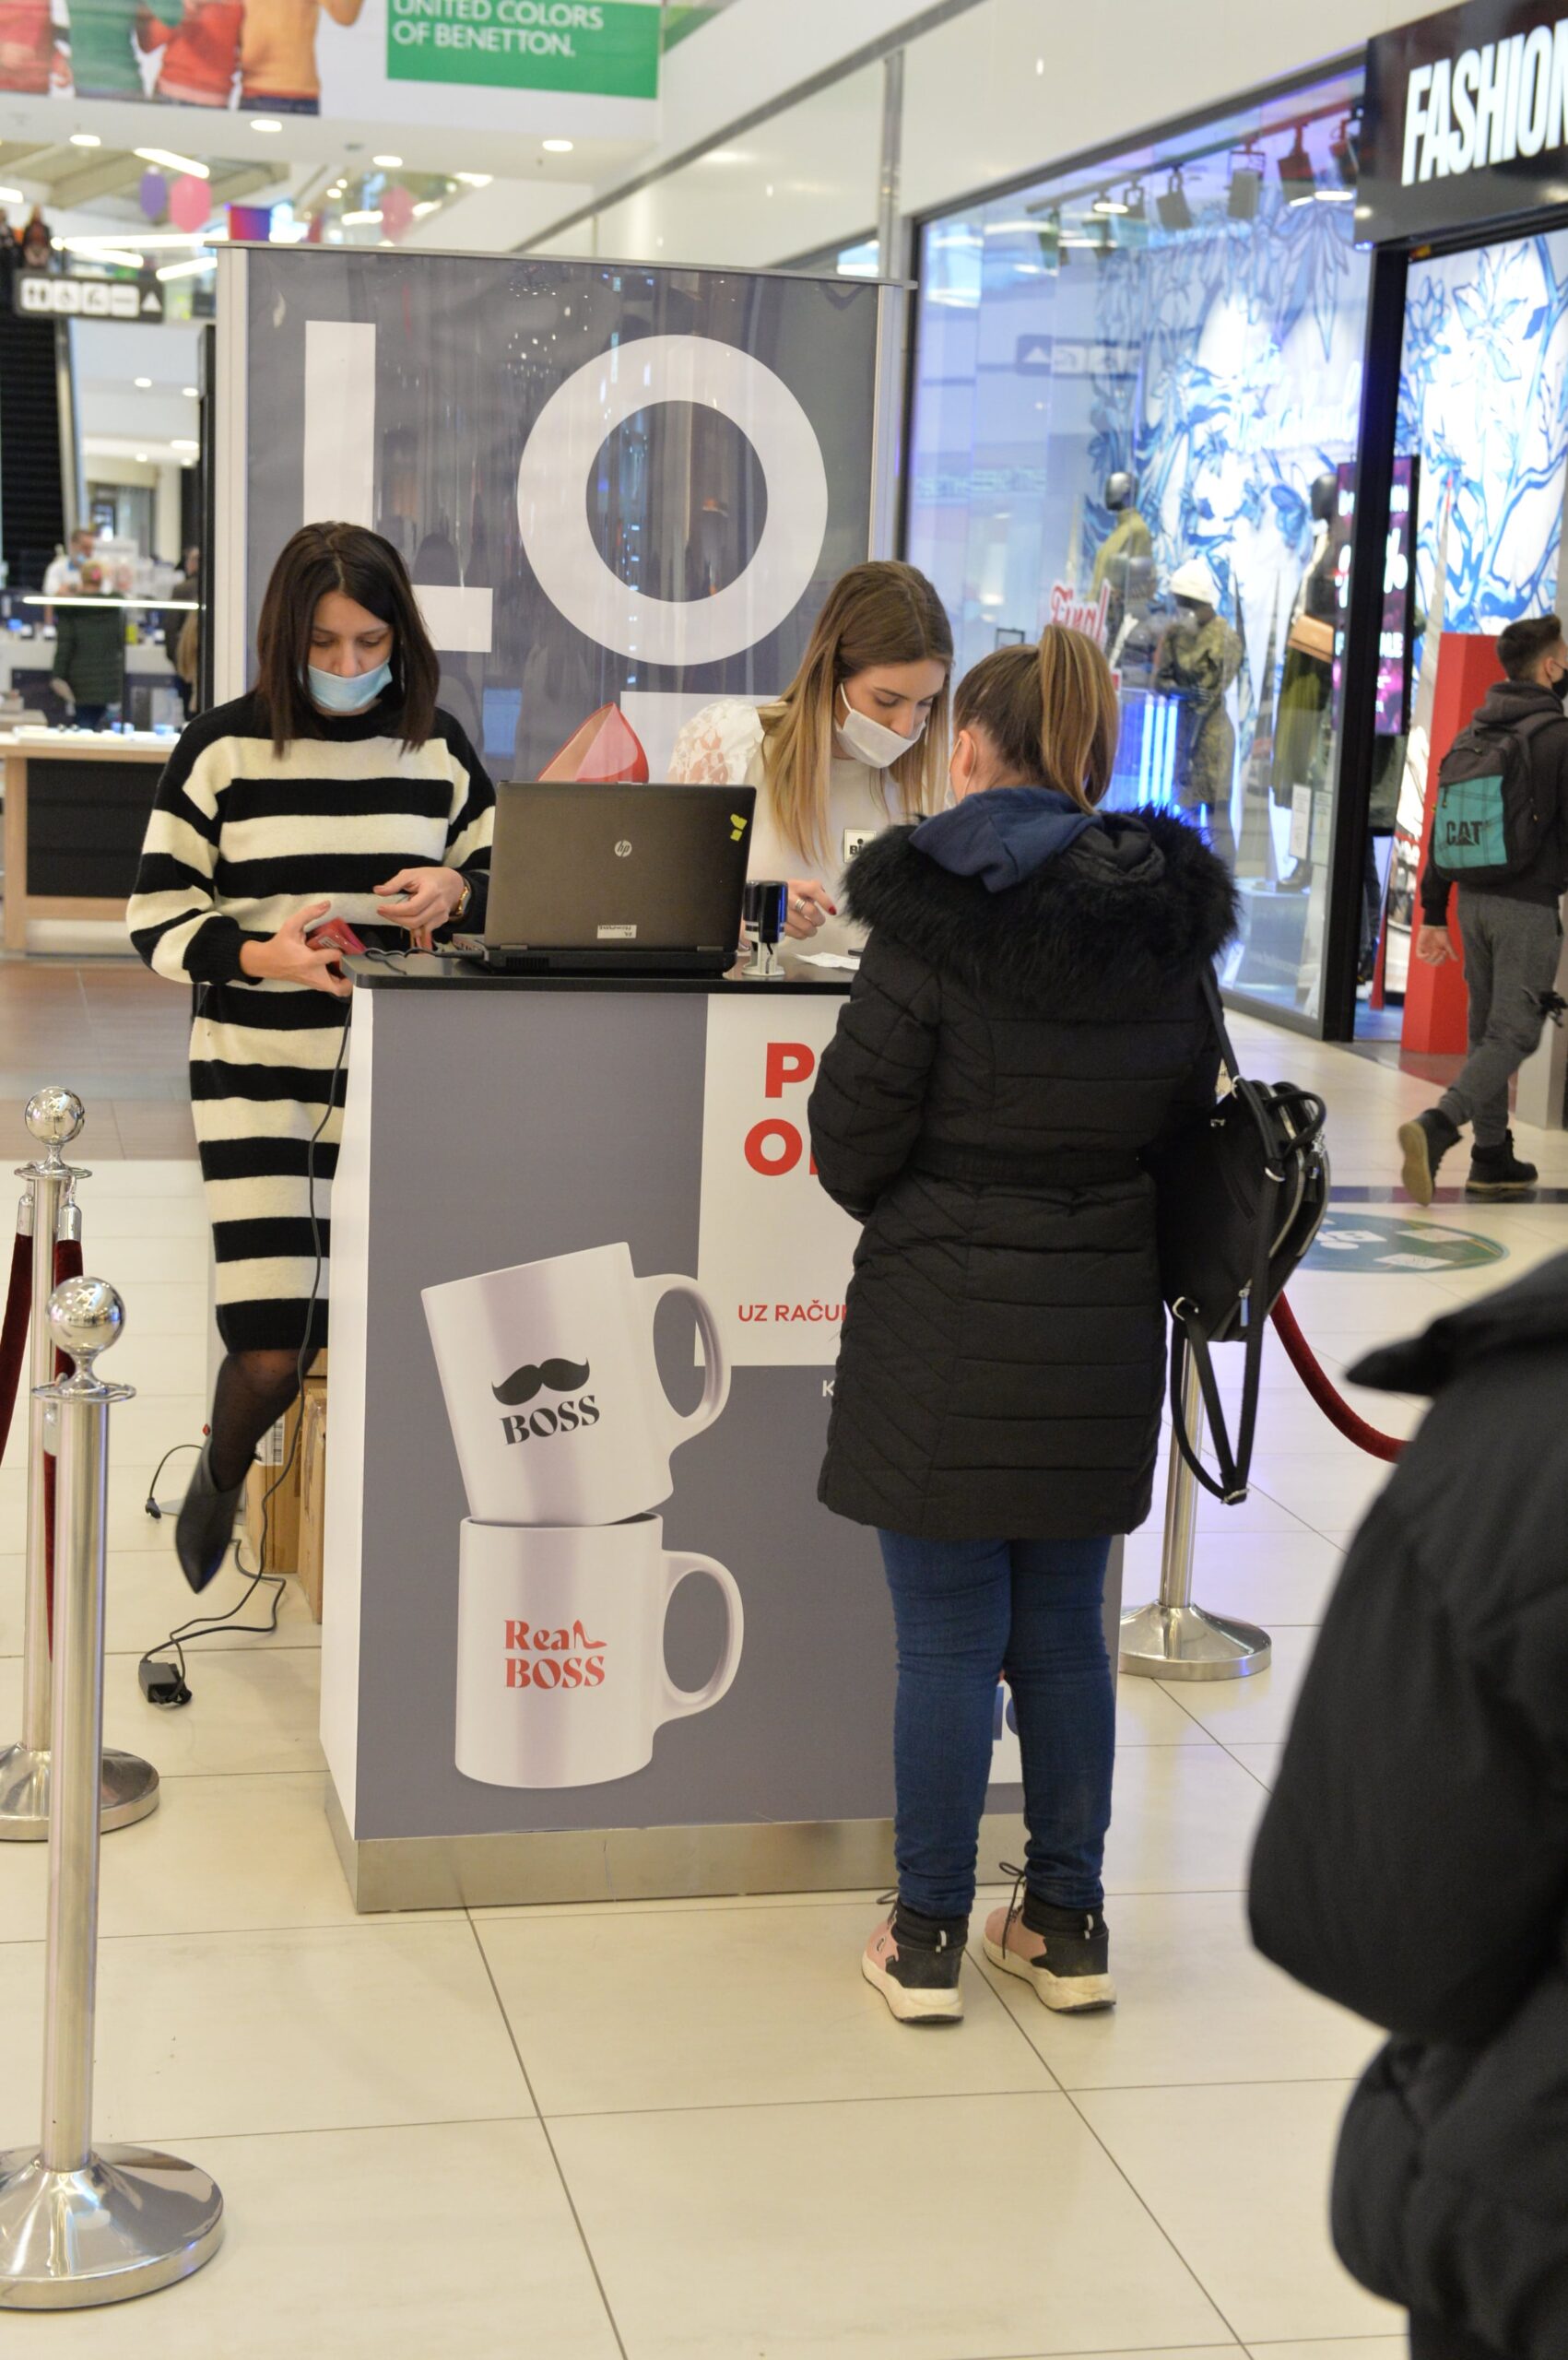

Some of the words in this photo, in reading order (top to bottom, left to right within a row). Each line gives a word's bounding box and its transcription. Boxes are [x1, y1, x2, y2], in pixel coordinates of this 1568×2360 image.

[393, 0, 492, 20] UNITED
[497, 0, 605, 30] COLORS
[392, 19, 430, 45] OF
[434, 24, 576, 57] BENETTON.
[615, 840, 631, 857] hp
[1445, 820, 1483, 846] CAT
[765, 1043, 816, 1098] P
[744, 1118, 819, 1176] O
[738, 1304, 768, 1322] UZ
[821, 1379, 835, 1397] K
[500, 1395, 600, 1445] BOSS
[504, 1656, 606, 1689] BOSS
